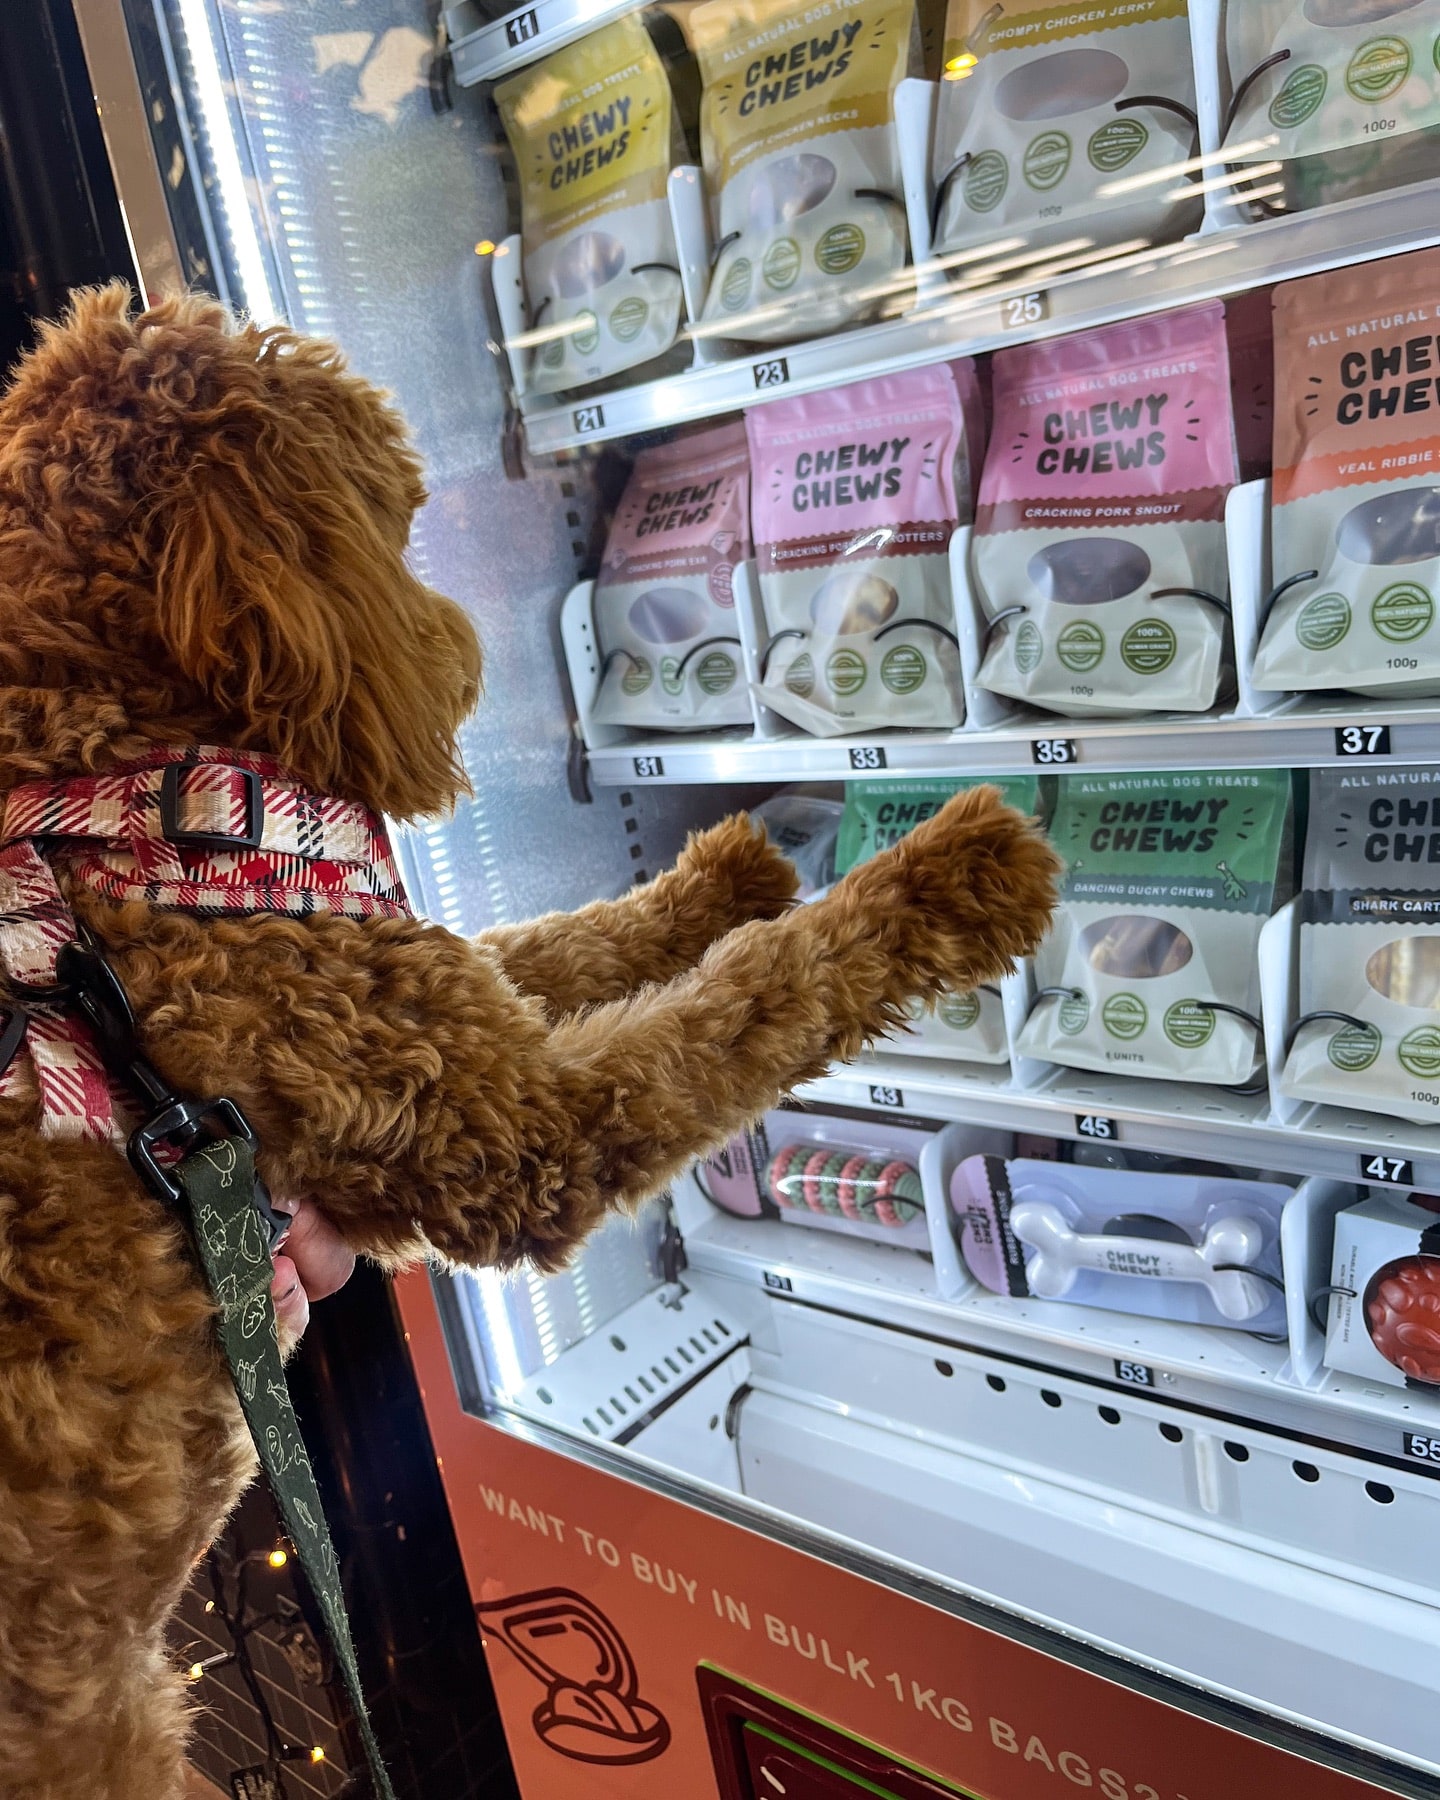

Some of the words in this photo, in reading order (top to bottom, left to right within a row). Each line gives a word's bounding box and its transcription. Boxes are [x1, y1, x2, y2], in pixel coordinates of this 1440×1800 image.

[510, 13, 535, 44] 11
[723, 47, 745, 63] ALL
[748, 17, 801, 50] NATURAL
[804, 6, 832, 24] DOG
[988, 22, 1042, 44] CHOMPY
[1045, 9, 1106, 31] CHICKEN
[1109, 0, 1156, 18] JERKY
[745, 19, 863, 88] CHEWY
[739, 50, 853, 117] CHEWS
[548, 95, 631, 162] CHEWY
[766, 118, 815, 145] CHICKEN
[817, 109, 859, 125] NECKS
[1362, 118, 1397, 134] 100g
[551, 130, 631, 191] CHEWS
[1007, 293, 1042, 326] 25
[1307, 330, 1339, 348] ALL
[1346, 309, 1428, 338] NATURAL
[1340, 335, 1440, 389] CHE
[756, 362, 785, 389] 23
[1018, 393, 1042, 408] ALL
[1044, 379, 1105, 402] NATURAL
[1109, 371, 1139, 386] DOG
[1143, 360, 1198, 378] TREATS
[1337, 378, 1440, 426] CHE
[576, 410, 601, 433] 21
[887, 411, 936, 427] TREATS
[1043, 392, 1169, 445] CHEWY
[795, 437, 911, 480] CHEWY
[1036, 431, 1166, 475] CHEWS
[1338, 461, 1377, 475] VEAL
[1381, 450, 1433, 470] RIBBIE
[646, 476, 724, 515] CHEWY
[792, 467, 903, 513] CHEWS
[635, 502, 715, 538] CHEWS
[1025, 507, 1092, 519] CRACKING
[1094, 506, 1132, 518] PORK
[1135, 504, 1181, 516] SNOUT
[776, 544, 828, 561] CRACKING
[1394, 607, 1430, 617] NATURAL
[1136, 627, 1163, 638] 100%
[1149, 642, 1171, 651] GRADE
[1385, 657, 1418, 670] 100g
[1070, 685, 1094, 697] 100g
[1036, 739, 1069, 764] 35
[1342, 726, 1384, 754] 37
[637, 757, 659, 776] 31
[853, 749, 880, 769] 33
[1081, 782, 1105, 793] ALL
[1108, 777, 1168, 790] NATURAL
[1172, 776, 1201, 788] DOG
[1206, 775, 1260, 788] TREATS
[1340, 776, 1371, 788] ALL
[1100, 797, 1229, 825] CHEWY
[1090, 826, 1219, 853] CHEWS
[1073, 882, 1124, 896] DANCING
[1127, 884, 1168, 897] DUCKY
[1170, 885, 1215, 899] CHEWS
[1352, 899, 1398, 912] SHARK
[1113, 1051, 1145, 1063] UNITS
[872, 1086, 898, 1105] 43
[1410, 1090, 1440, 1106] 100g
[1079, 1116, 1111, 1138] 45
[1366, 1156, 1406, 1182] 47
[1106, 1250, 1160, 1267] CHEWY
[1119, 1361, 1149, 1384] 53
[1411, 1435, 1440, 1462] 55
[478, 1482, 566, 1543] WANT
[574, 1527, 620, 1568] TO
[630, 1551, 699, 1604] BUY
[711, 1588, 752, 1631] IN
[764, 1613, 875, 1690] BULK
[885, 1671, 974, 1733] 1KG
